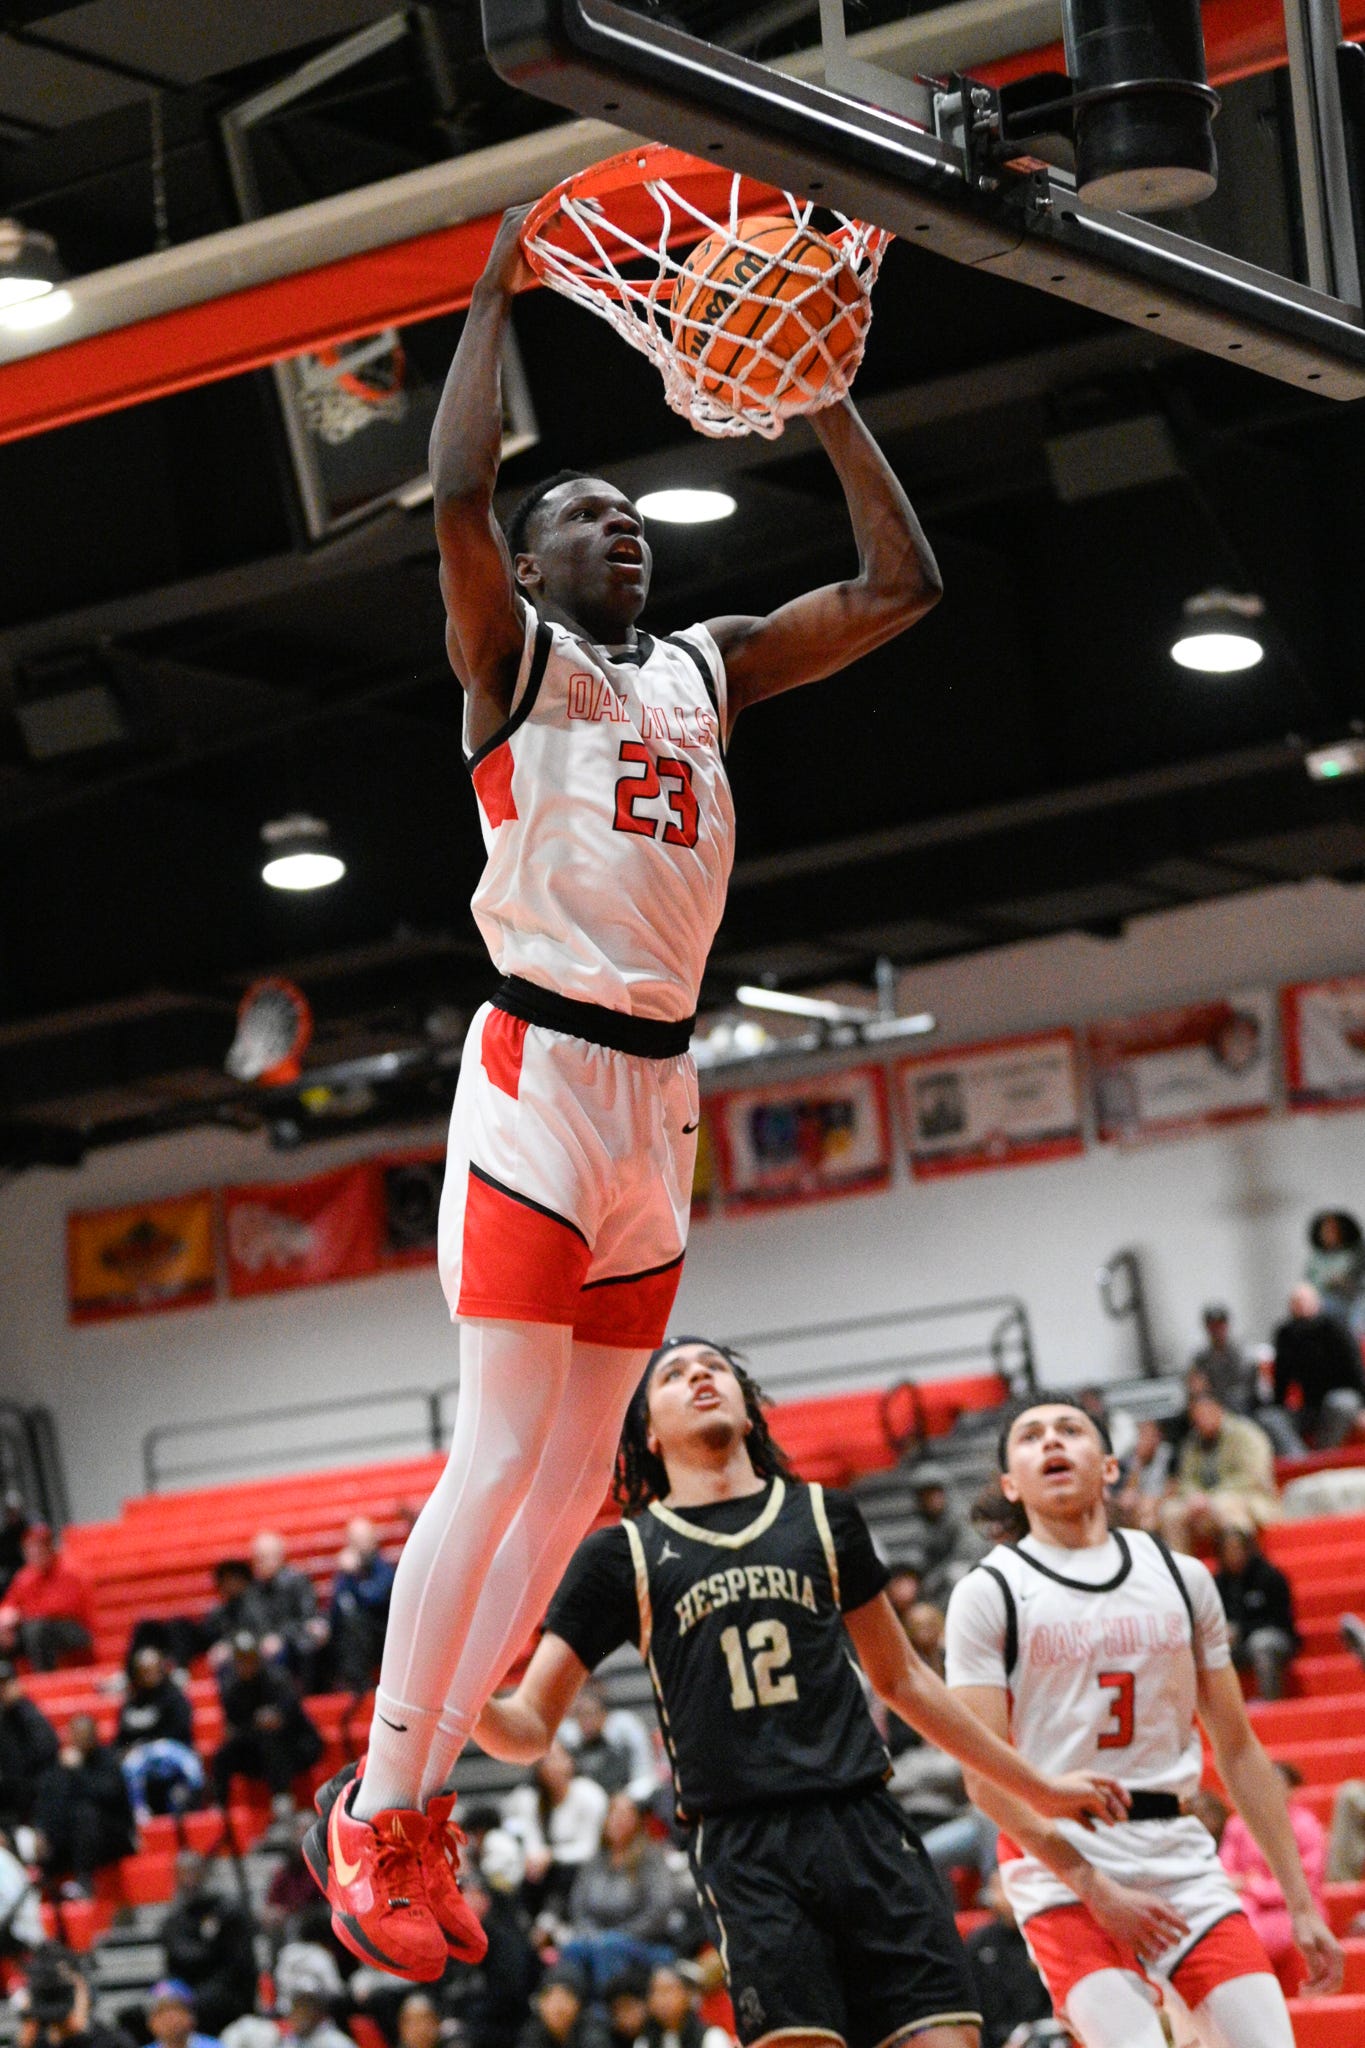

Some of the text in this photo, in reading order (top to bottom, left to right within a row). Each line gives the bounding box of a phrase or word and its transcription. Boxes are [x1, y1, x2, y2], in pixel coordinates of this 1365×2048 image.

[612, 739, 699, 849] 23
[673, 1564, 818, 1636] HESPERIA
[1029, 1612, 1187, 1667] OAK HILLS
[719, 1618, 799, 1711] 12
[1097, 1671, 1135, 1750] 3
